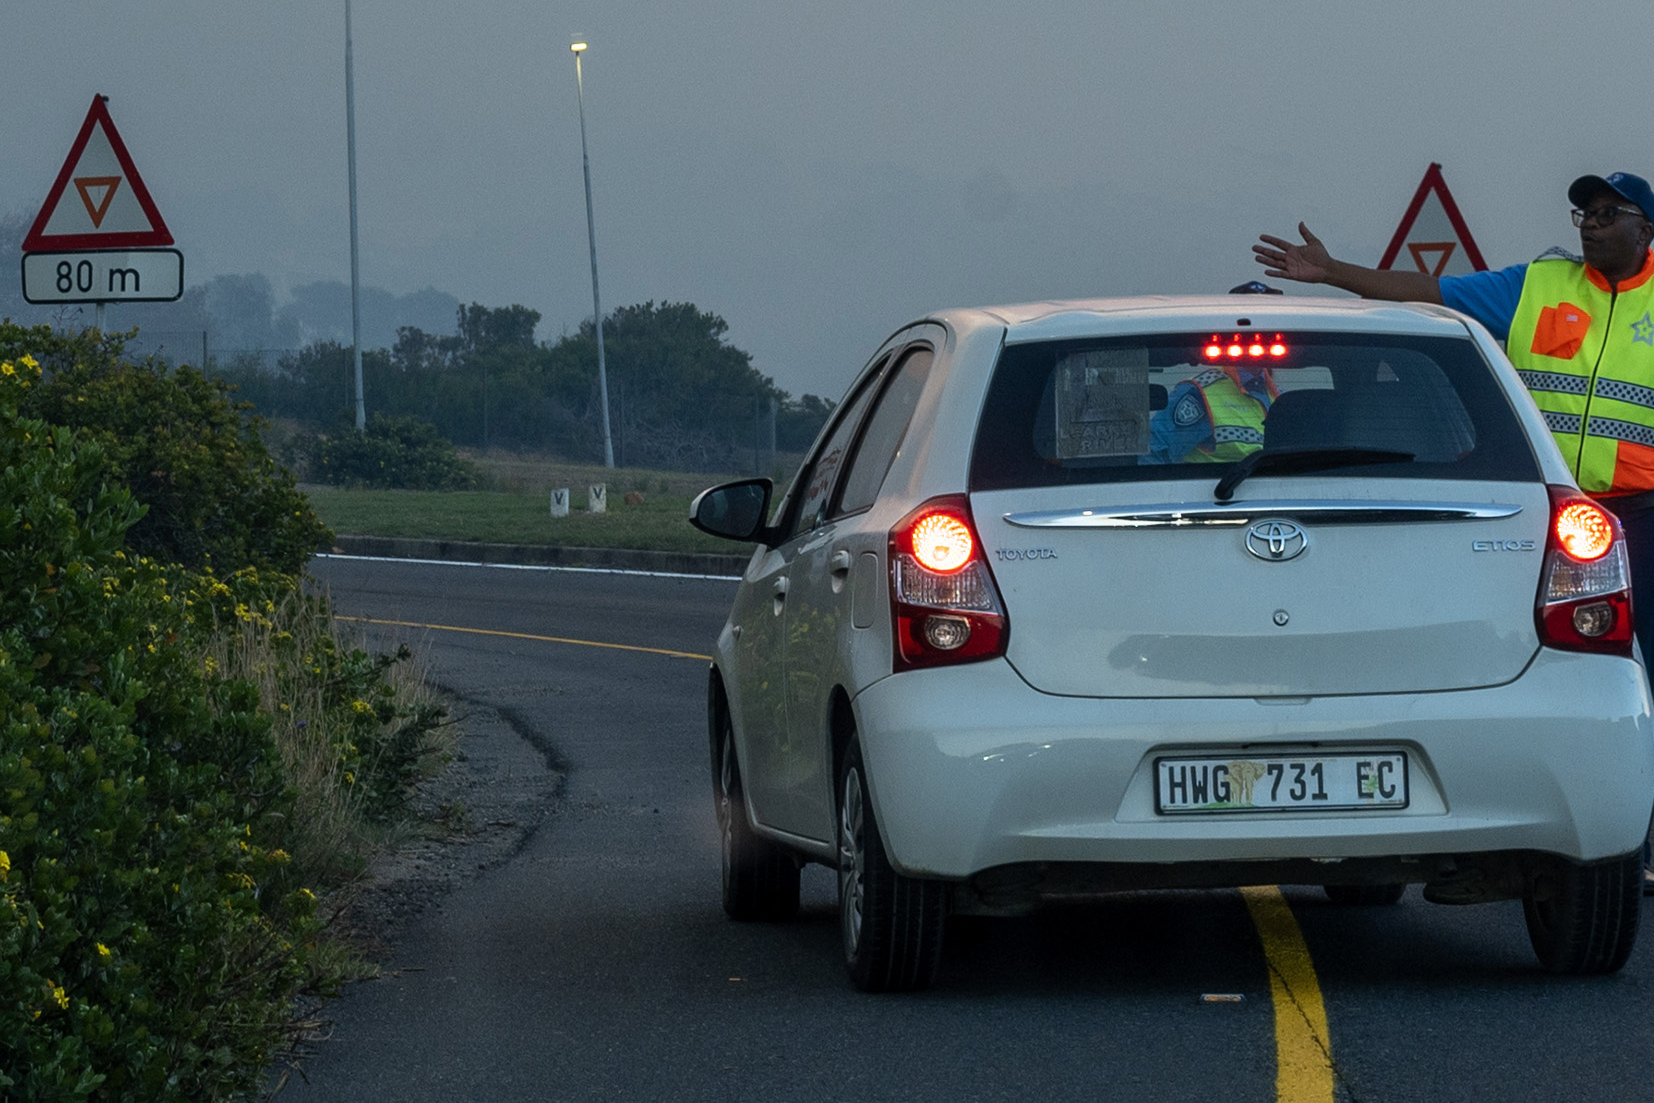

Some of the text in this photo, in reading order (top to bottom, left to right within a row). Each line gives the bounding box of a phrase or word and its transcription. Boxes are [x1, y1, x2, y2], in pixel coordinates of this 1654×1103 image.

[56, 259, 140, 294] 80 m
[554, 492, 564, 505] V
[593, 487, 603, 499] V
[1472, 539, 1536, 552] ETIOS
[995, 547, 1058, 561] TOYOTA
[1168, 760, 1396, 805] HWG 731 EC
